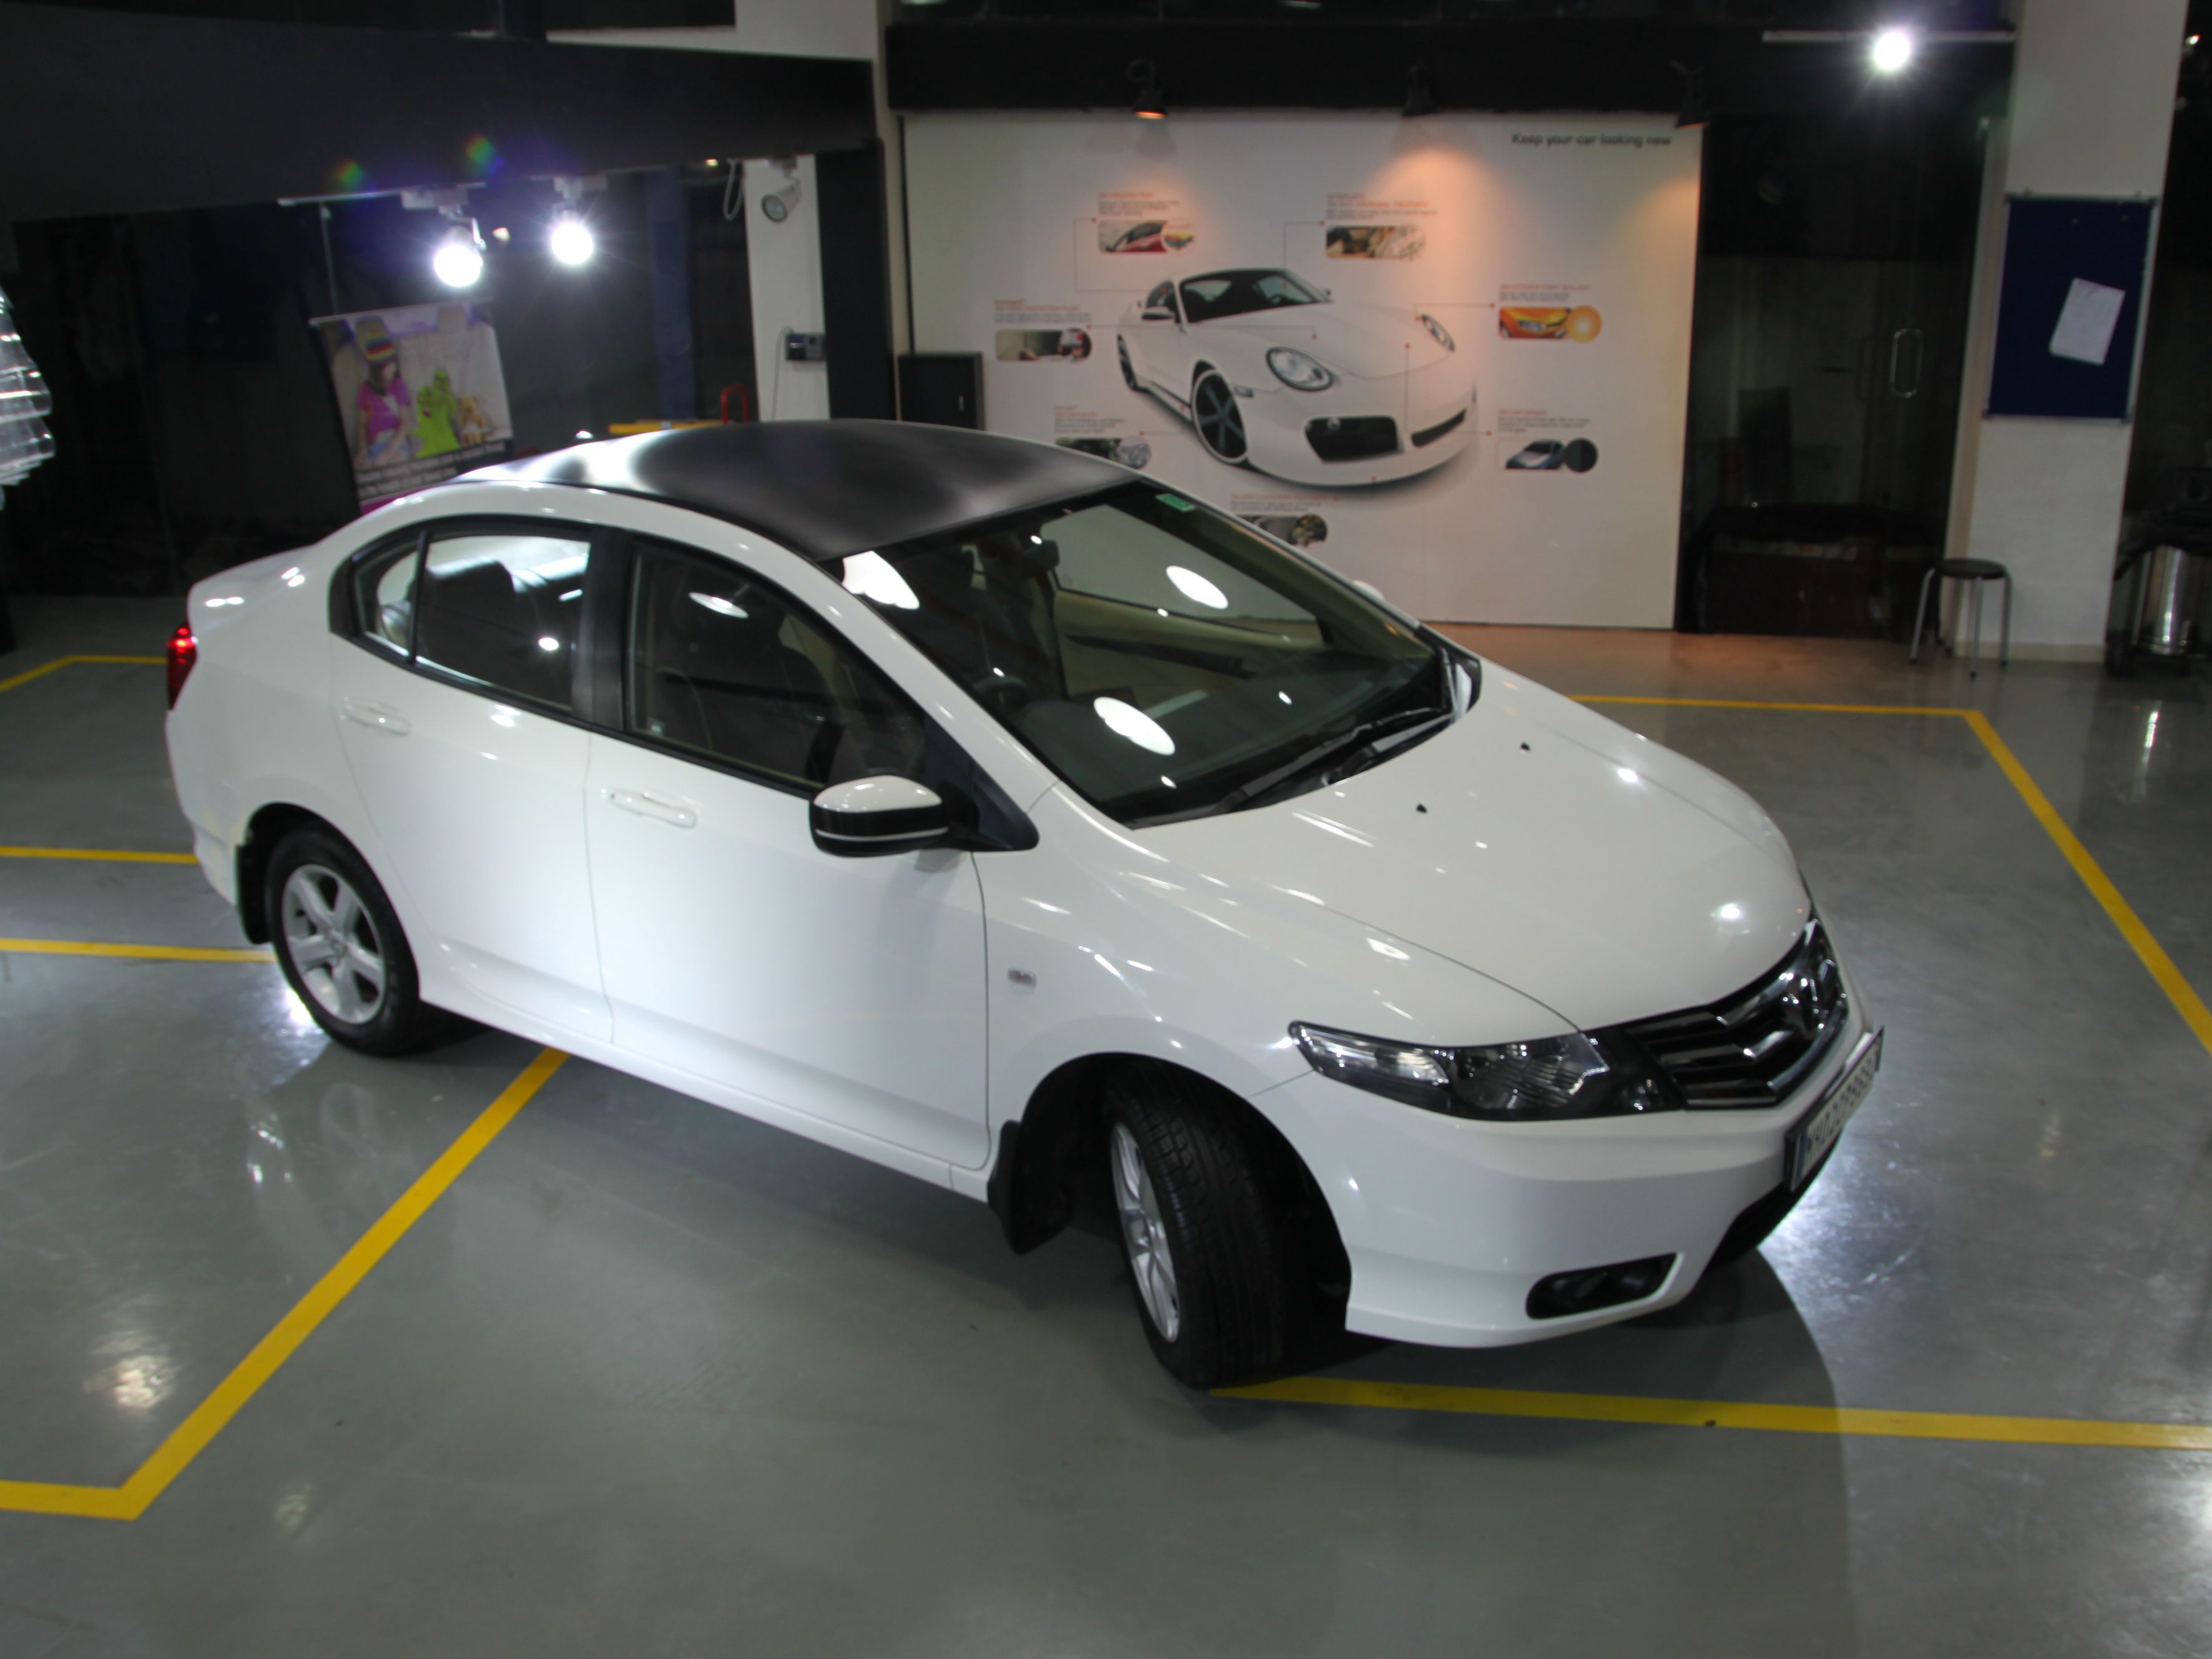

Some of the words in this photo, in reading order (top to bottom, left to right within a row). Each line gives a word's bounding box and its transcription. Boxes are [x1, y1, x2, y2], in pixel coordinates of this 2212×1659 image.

[1512, 133, 1543, 147] Keep
[1546, 135, 1573, 147] your
[1576, 135, 1596, 145] car
[1600, 132, 1643, 148] looking
[1646, 135, 1672, 145] new
